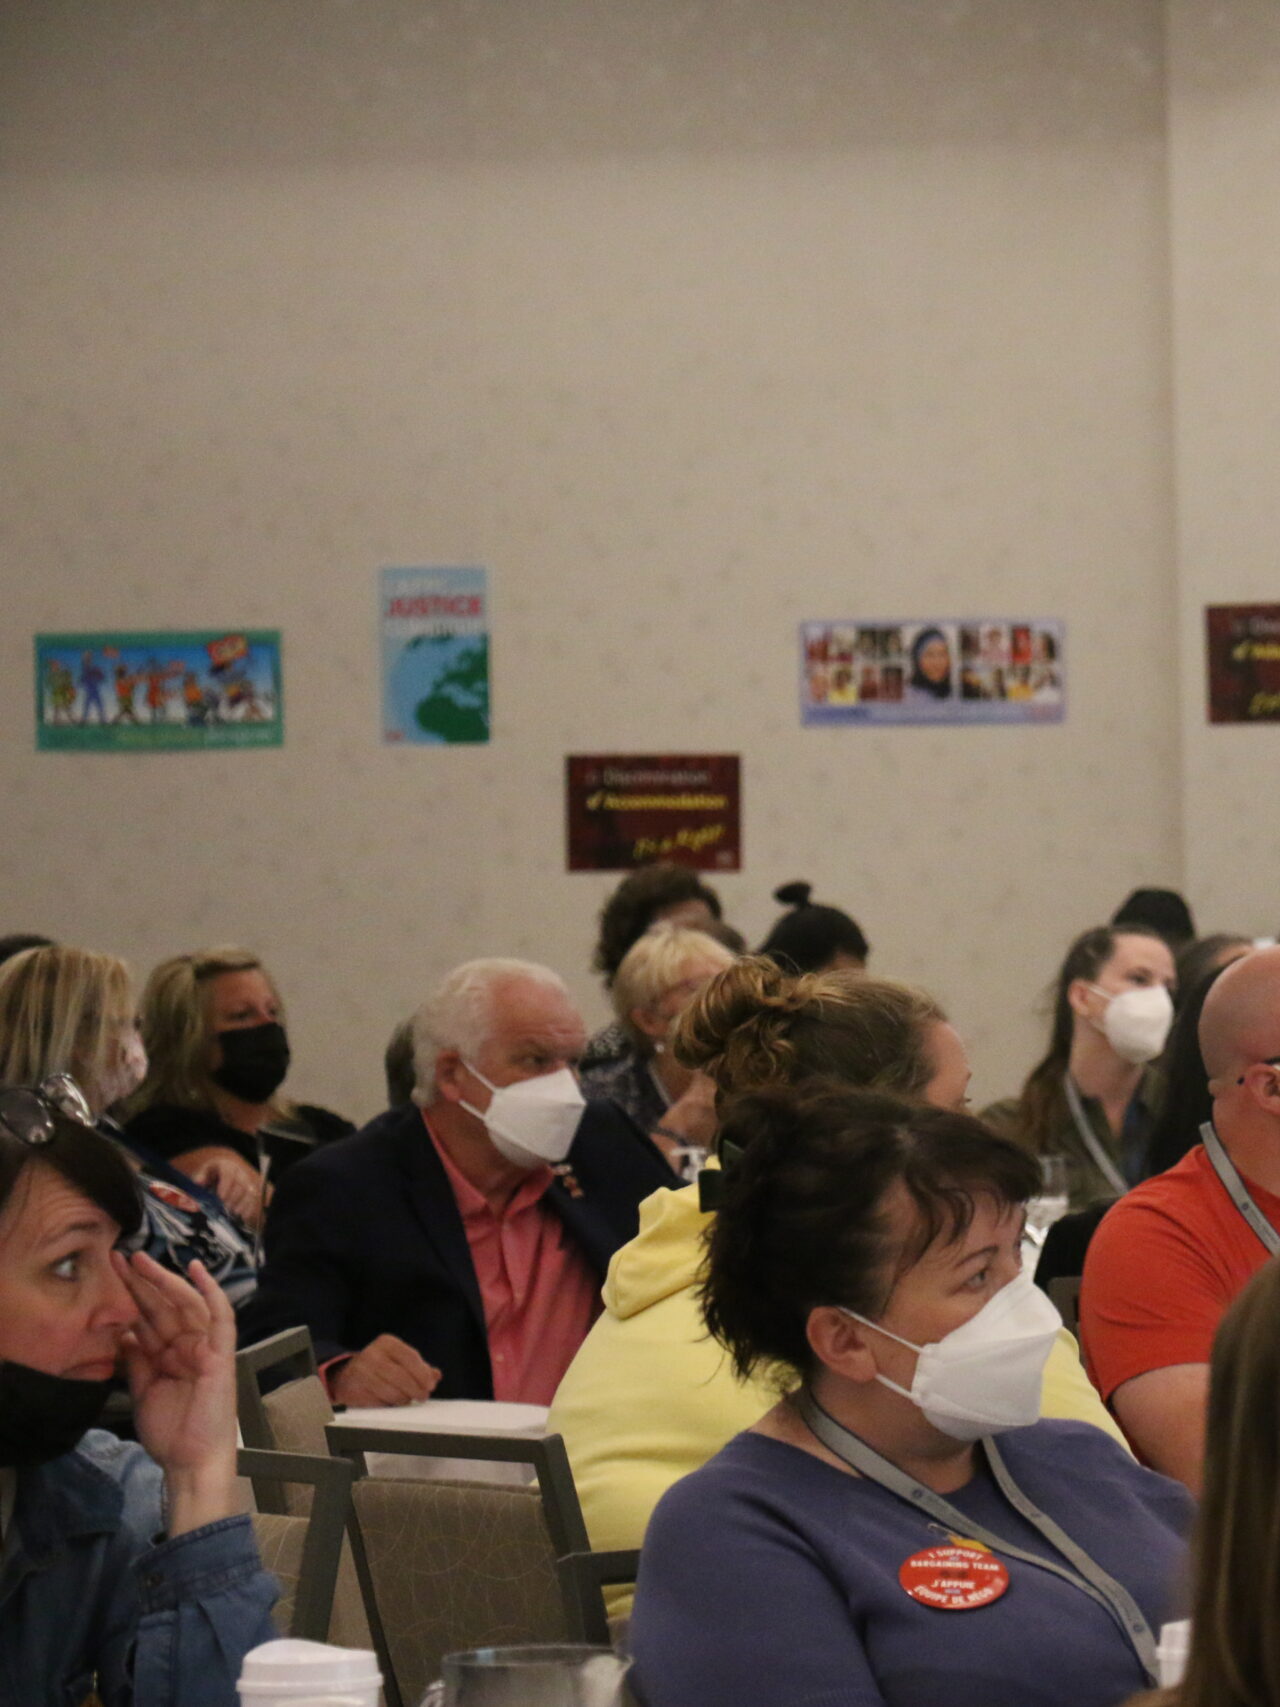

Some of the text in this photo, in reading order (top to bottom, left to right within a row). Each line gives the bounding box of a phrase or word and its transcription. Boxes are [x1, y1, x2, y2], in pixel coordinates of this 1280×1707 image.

[386, 595, 483, 619] JUSTICE
[603, 768, 711, 787] Discrimination
[603, 792, 730, 811] Accommodation
[936, 1548, 984, 1560] SUPPORT
[911, 1560, 999, 1571] BARGAINING TEAM
